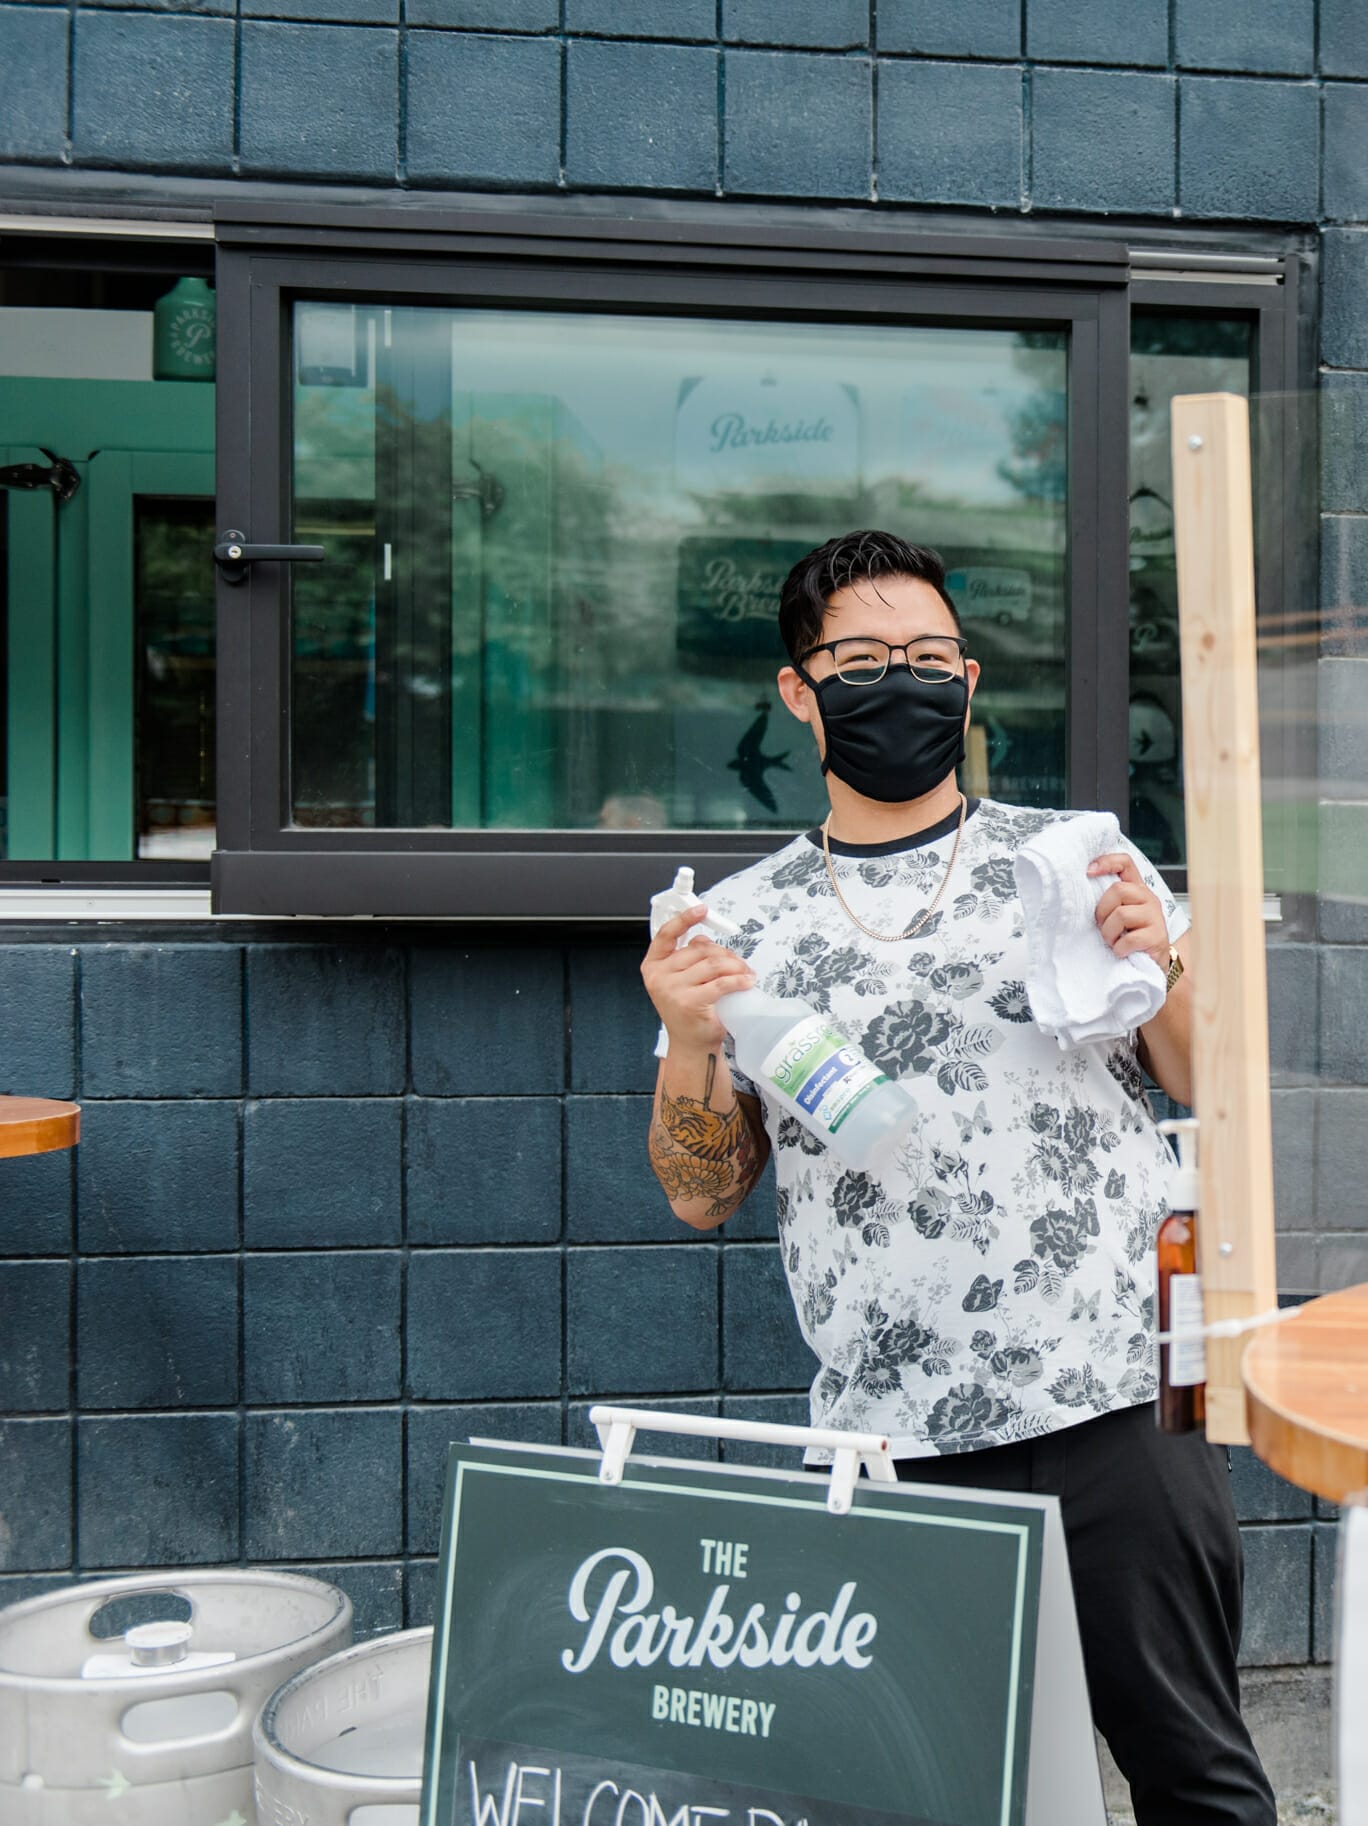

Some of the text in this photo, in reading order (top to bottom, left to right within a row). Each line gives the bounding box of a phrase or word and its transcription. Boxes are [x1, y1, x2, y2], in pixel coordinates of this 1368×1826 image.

[709, 412, 834, 453] Parkside
[700, 1538, 750, 1580] THE
[561, 1546, 879, 1674] Parkside
[652, 1684, 777, 1739] BREWERY
